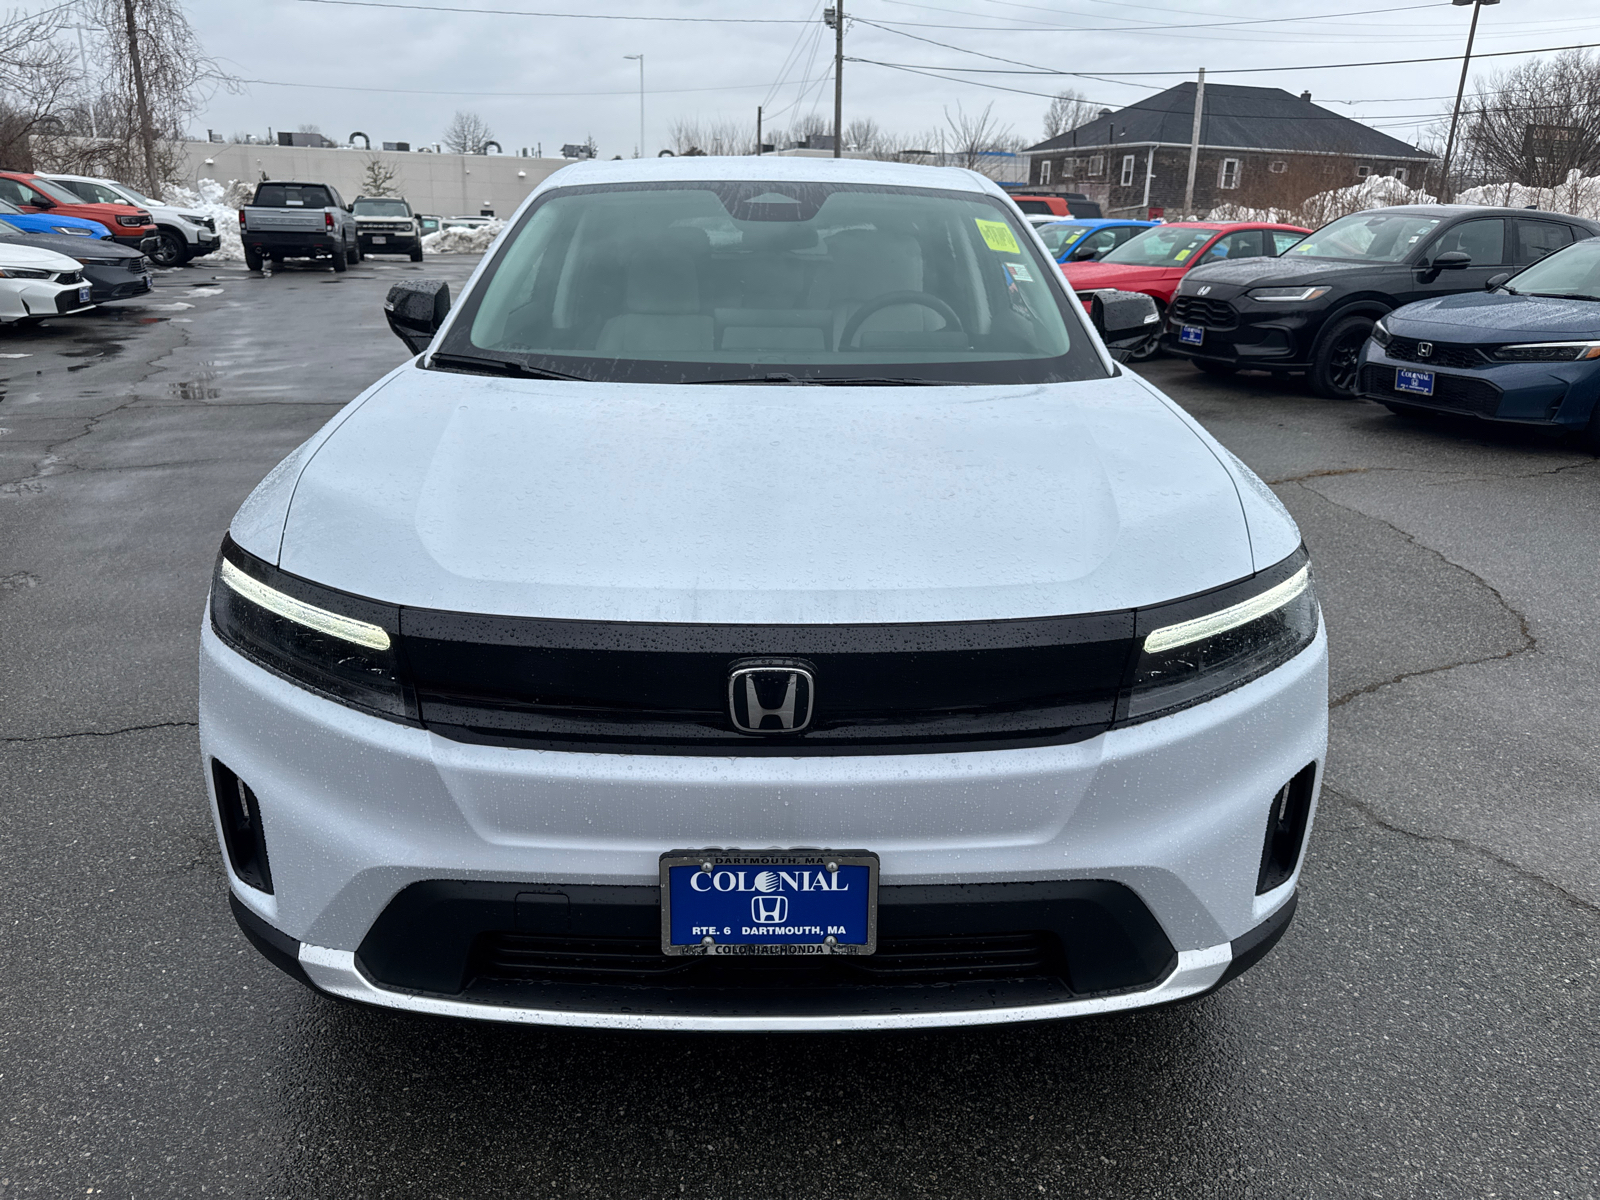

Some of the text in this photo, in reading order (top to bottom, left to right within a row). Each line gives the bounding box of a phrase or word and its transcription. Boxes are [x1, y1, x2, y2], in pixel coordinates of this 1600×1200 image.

[715, 857, 801, 865] DARTMOUTH,
[690, 871, 849, 893] COLONIAL
[692, 925, 847, 936] RTE. 6 DARTMOUTH, MA
